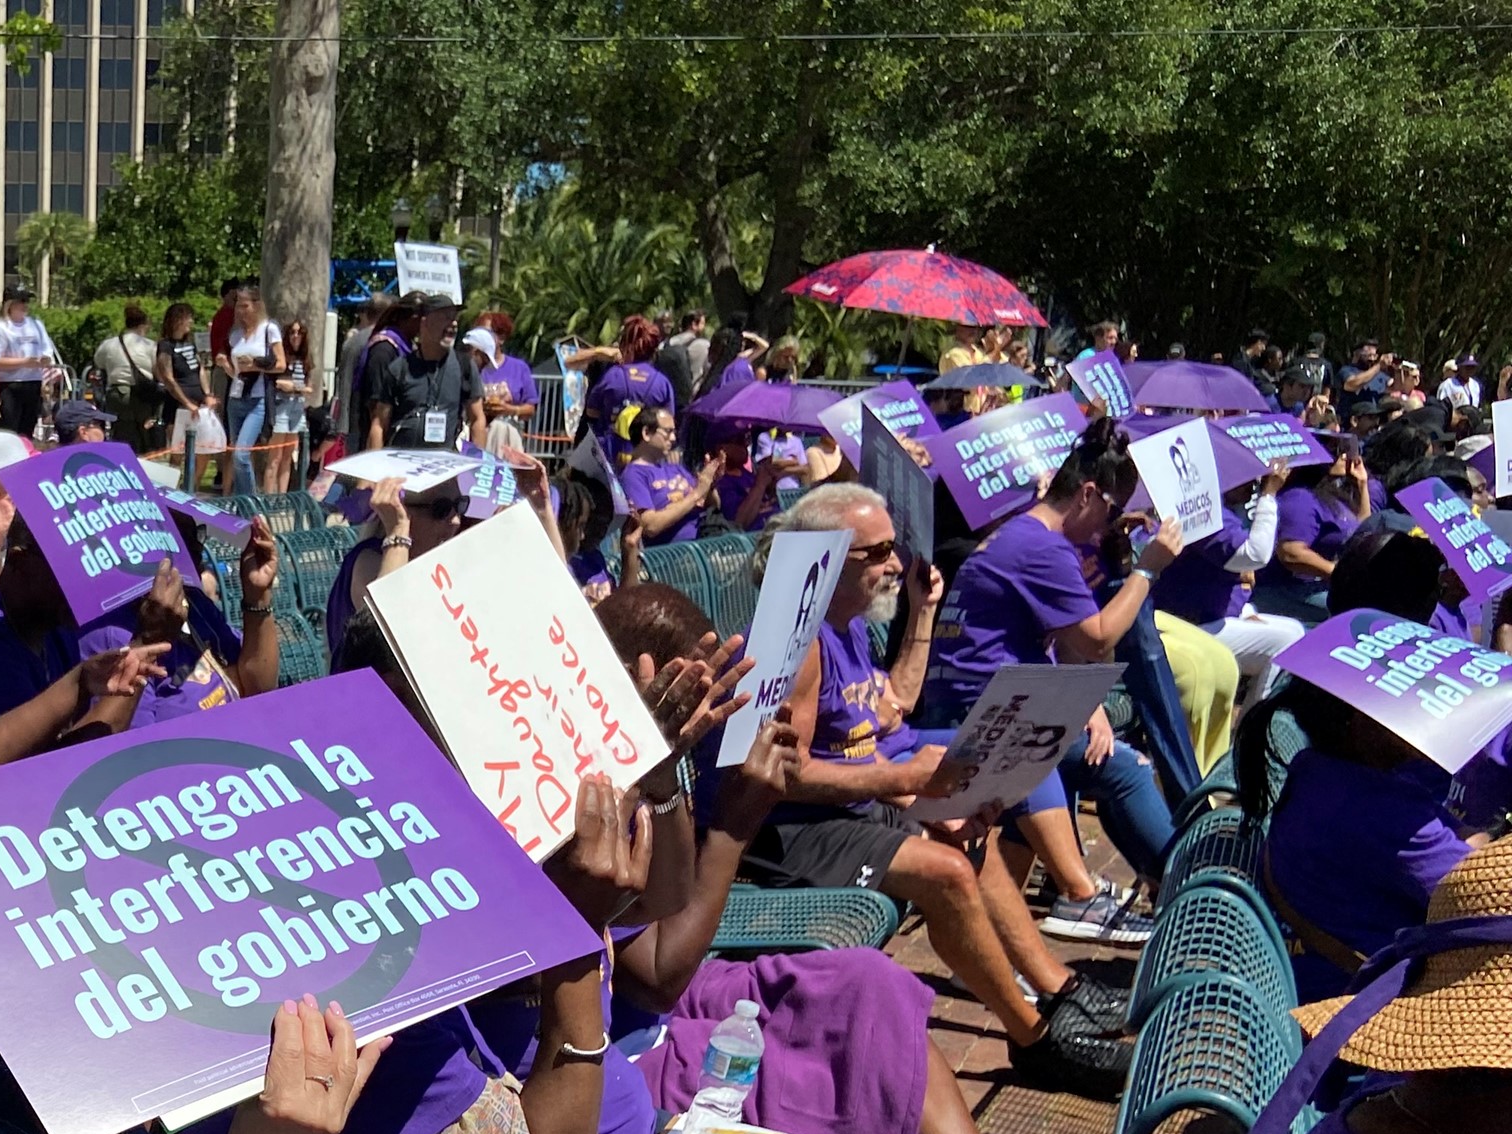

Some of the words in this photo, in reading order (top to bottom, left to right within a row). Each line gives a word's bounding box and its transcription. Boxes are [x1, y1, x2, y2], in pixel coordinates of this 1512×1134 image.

[955, 416, 1047, 460] Detengan
[1044, 411, 1067, 429] la
[38, 468, 131, 511] Detengan
[119, 463, 145, 491] la
[976, 474, 1010, 501] del
[53, 495, 166, 546] interferencia
[79, 536, 122, 578] del
[119, 524, 181, 566] gobierno
[1465, 546, 1494, 574] del
[431, 562, 572, 836] Daughters
[1415, 671, 1474, 720] del
[289, 738, 374, 793] la
[5, 795, 440, 969] interferencia
[73, 947, 184, 1040] del
[198, 866, 481, 1008] gobierno
